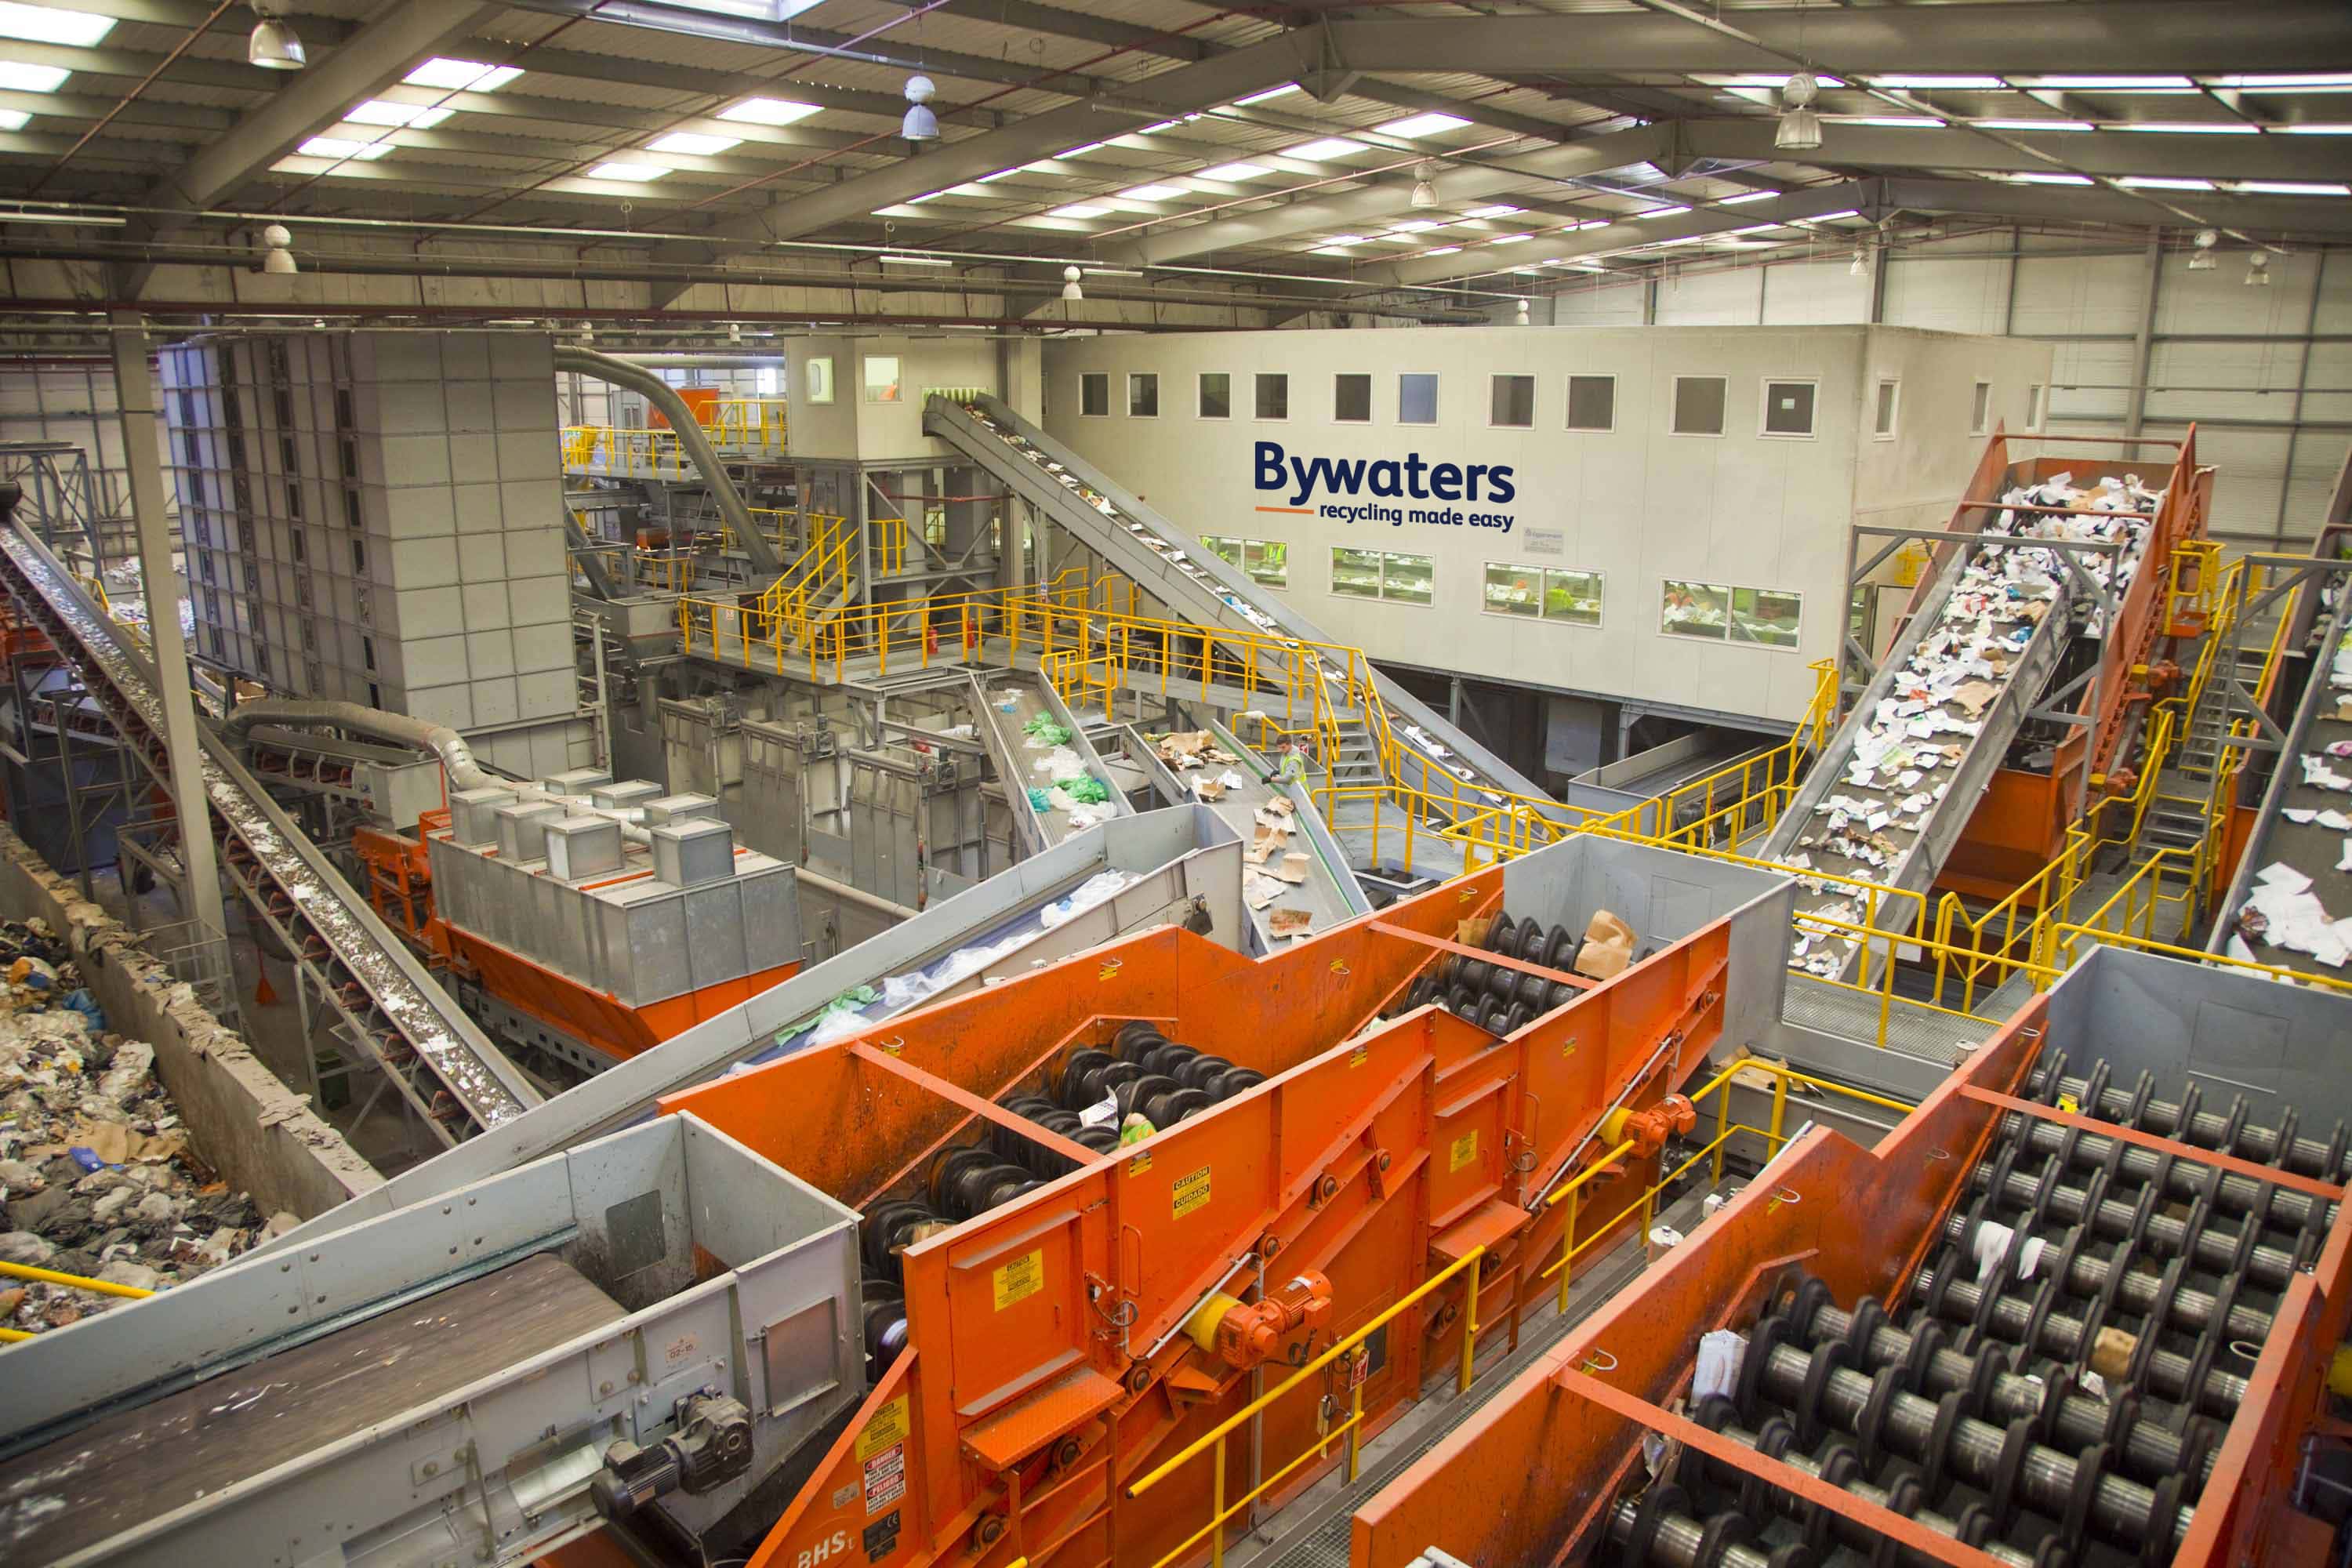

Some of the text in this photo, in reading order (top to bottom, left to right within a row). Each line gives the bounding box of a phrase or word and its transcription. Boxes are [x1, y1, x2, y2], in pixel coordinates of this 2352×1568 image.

[1254, 441, 1515, 506] Bywaters
[1319, 503, 1403, 526] recycling
[1409, 508, 1463, 525] made
[1468, 514, 1515, 533] easy
[1175, 1167, 1208, 1197] CAUTION
[1175, 1185, 1208, 1215] CUIDADO
[872, 1450, 897, 1471] DANGER
[873, 1475, 899, 1494] PELIGRO
